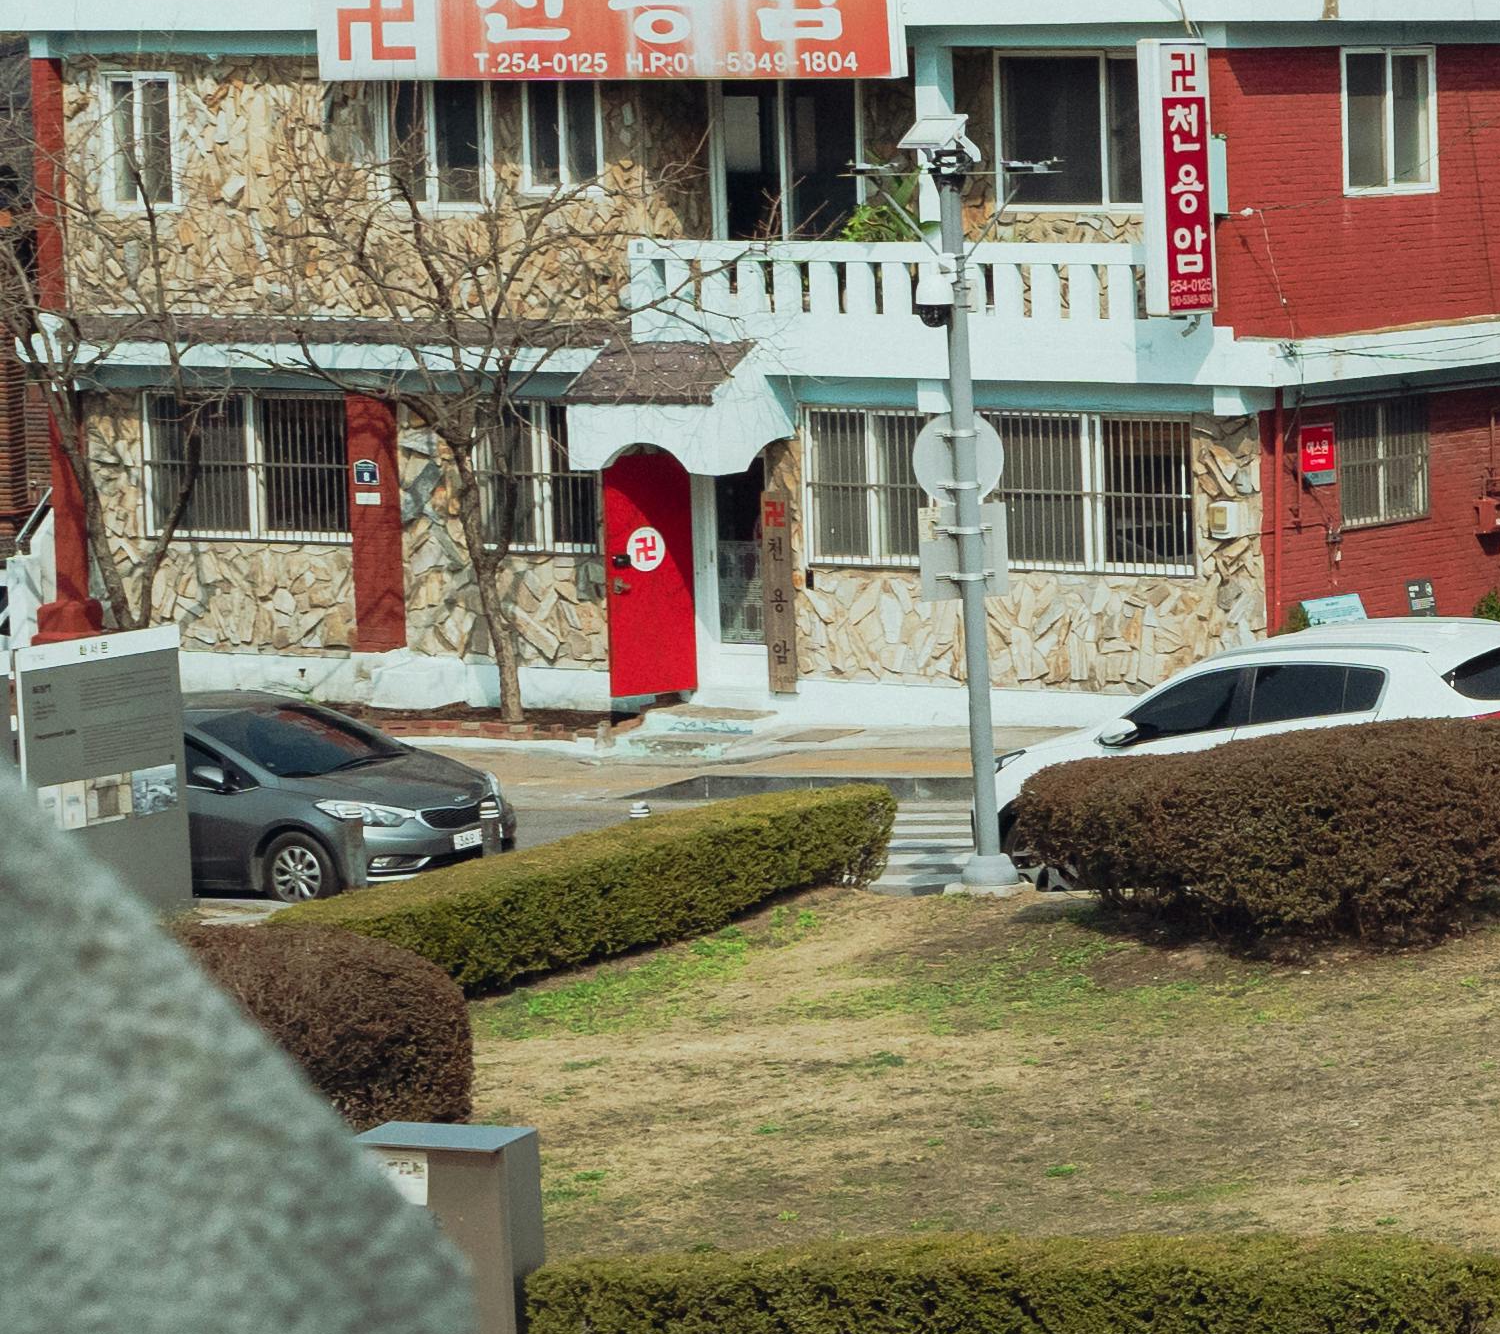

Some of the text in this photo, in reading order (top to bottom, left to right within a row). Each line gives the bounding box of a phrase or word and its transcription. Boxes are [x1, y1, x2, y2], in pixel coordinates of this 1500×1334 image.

[1167, 103, 1208, 274] 천용암
[363, 471, 370, 482] 8
[1306, 441, 1329, 455] 에스원
[767, 537, 790, 665] 천용암
